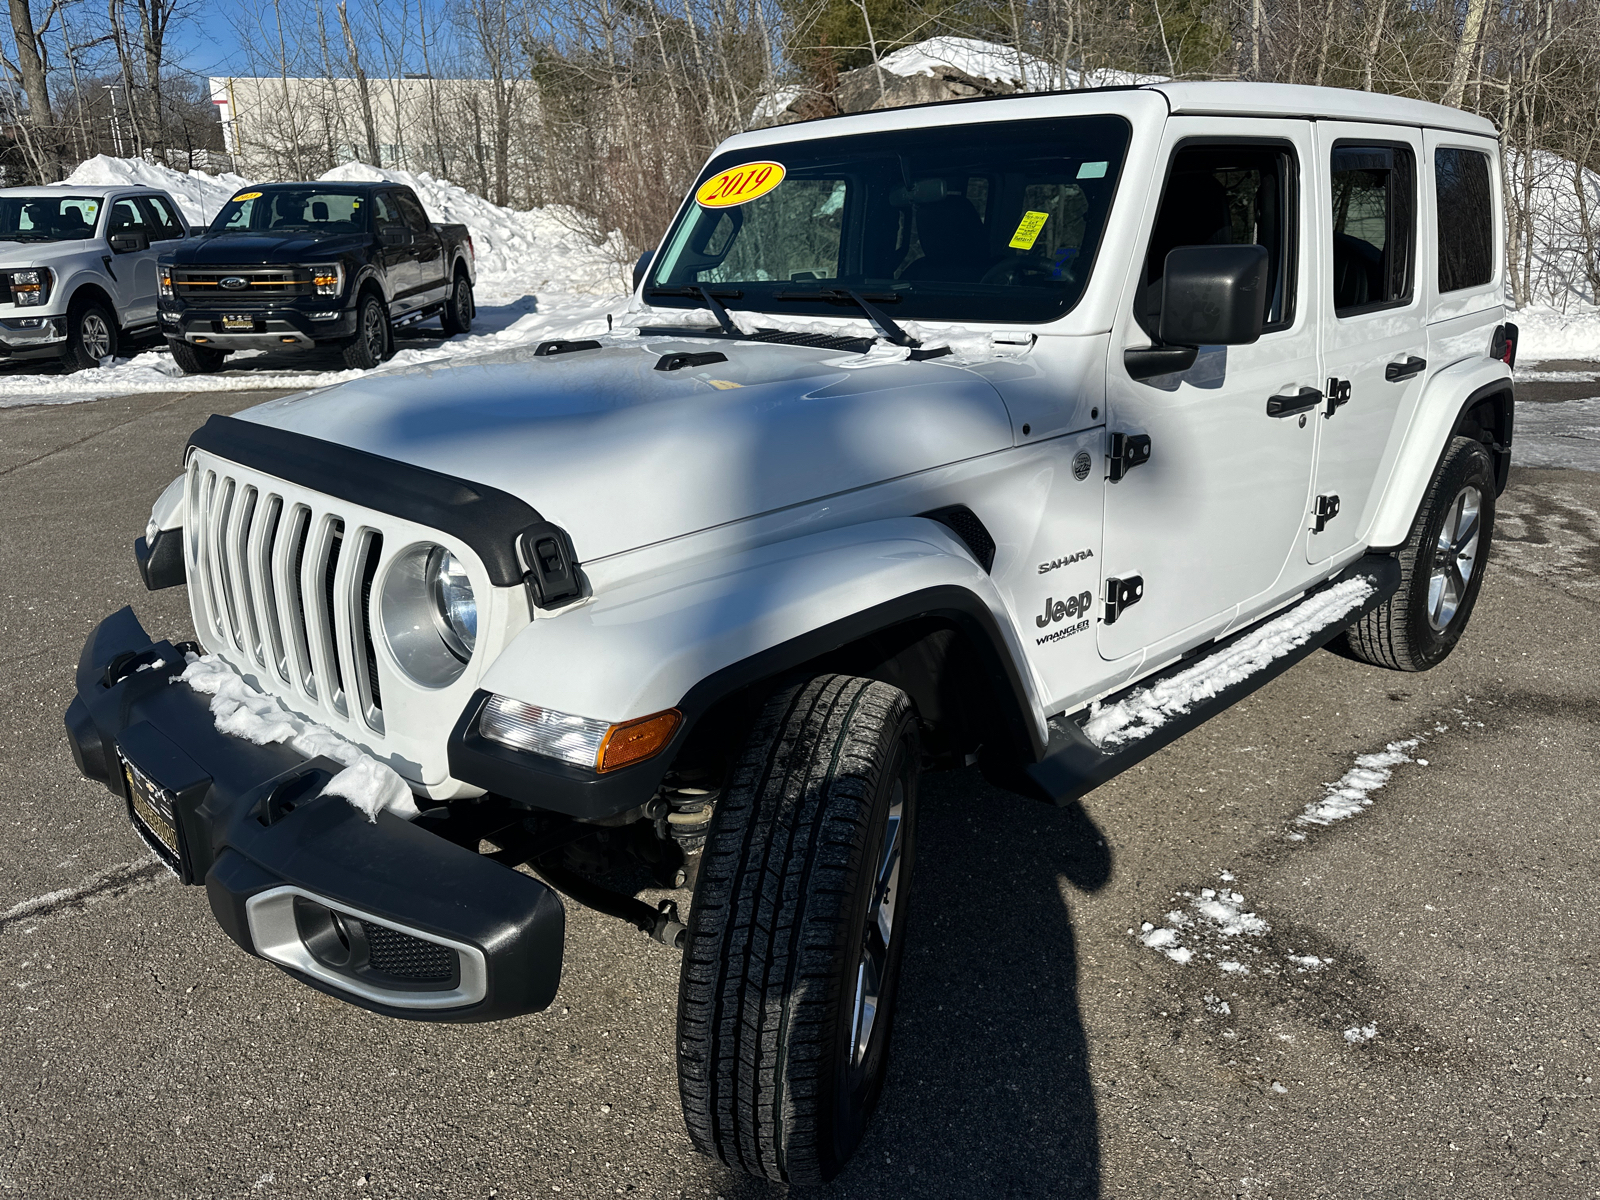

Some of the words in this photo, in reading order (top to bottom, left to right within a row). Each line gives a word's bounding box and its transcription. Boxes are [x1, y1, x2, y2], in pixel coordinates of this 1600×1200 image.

[705, 166, 772, 201] 2019
[1037, 548, 1094, 575] SAHARA
[1035, 590, 1092, 628] Jeep
[1035, 619, 1090, 646] WRANGLER
[1052, 625, 1090, 643] UNLIMITED
